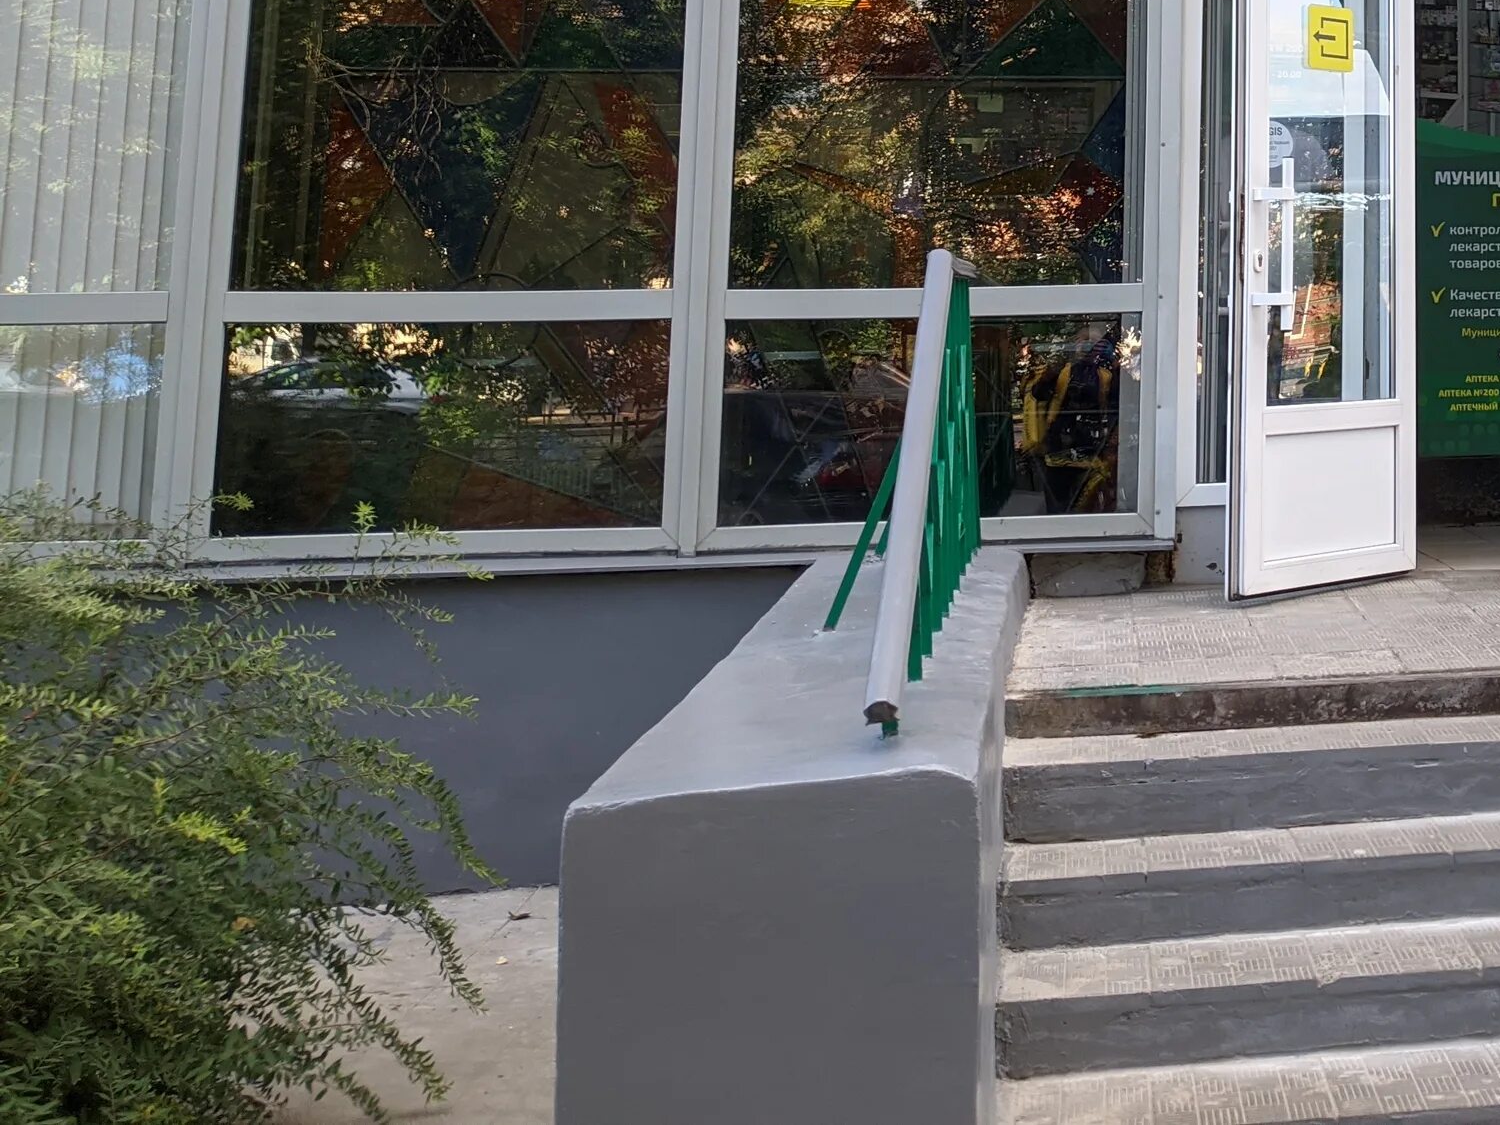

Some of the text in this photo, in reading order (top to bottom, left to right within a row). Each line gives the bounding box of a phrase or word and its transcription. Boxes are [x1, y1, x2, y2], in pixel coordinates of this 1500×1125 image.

[1465, 375, 1500, 383] АПТЕКА
[1438, 389, 1472, 398] АПТЕКА
[1450, 401, 1498, 411] АПТЕЧНЫЙ
